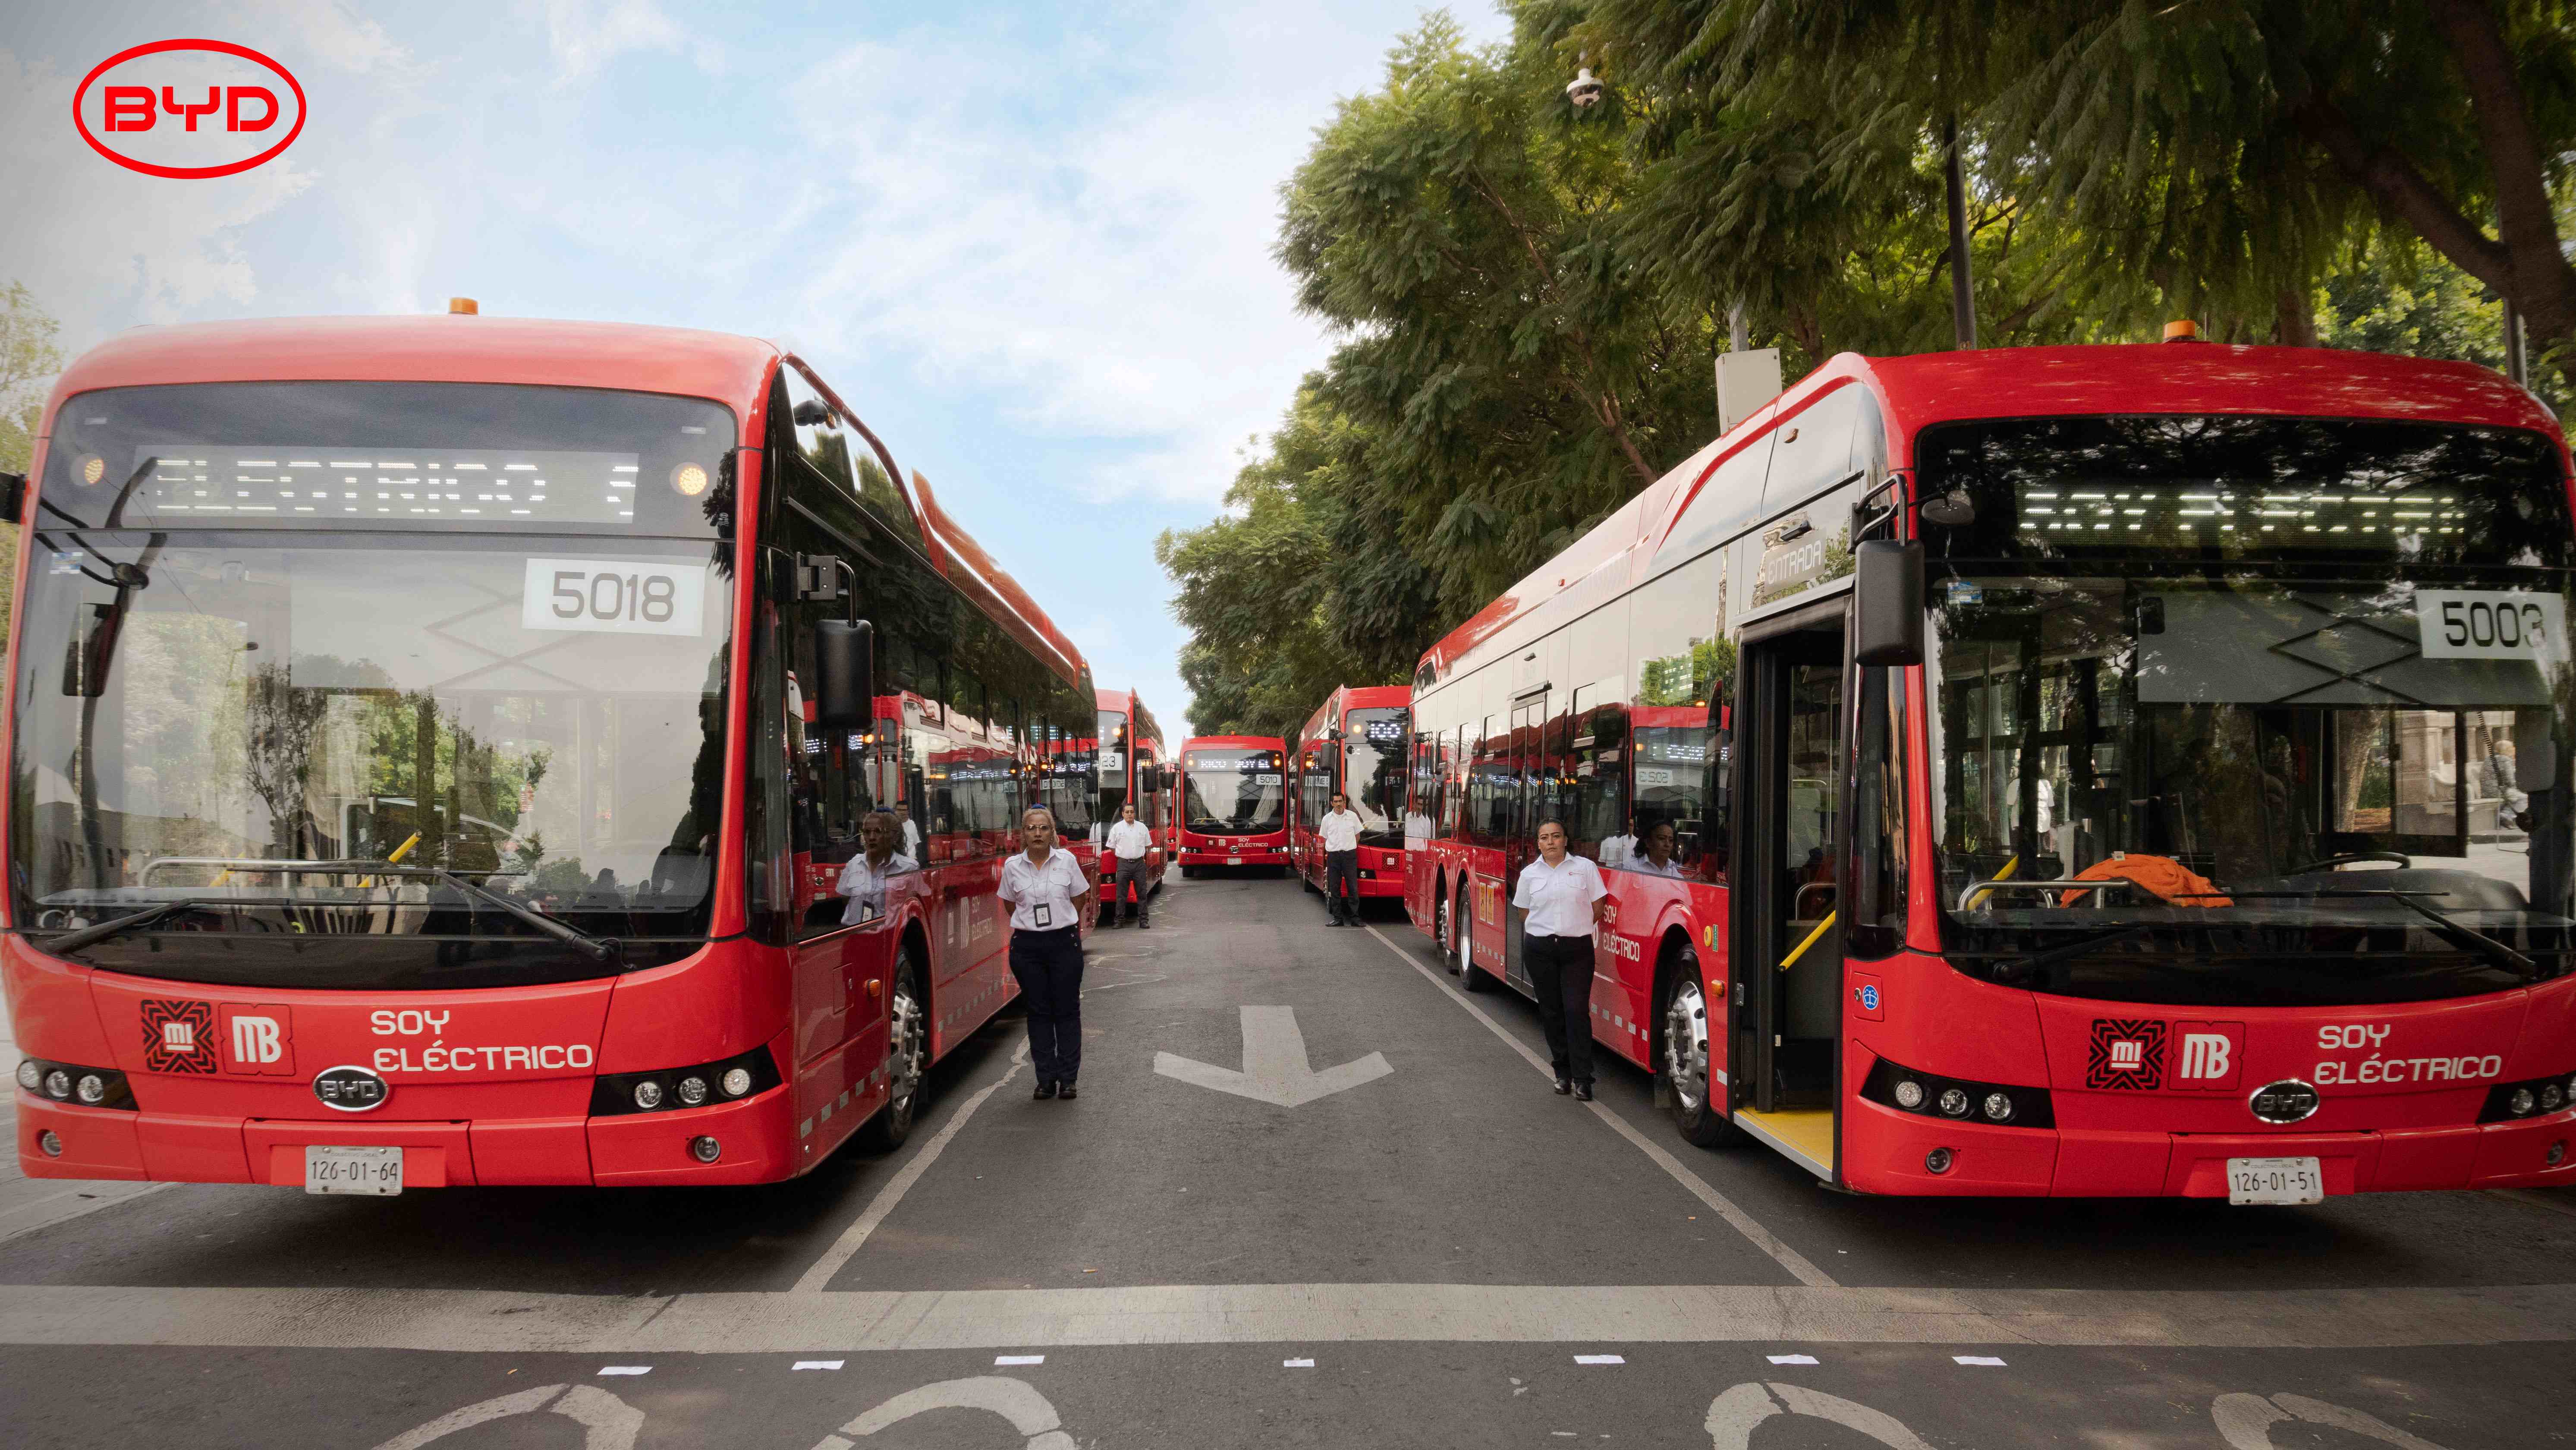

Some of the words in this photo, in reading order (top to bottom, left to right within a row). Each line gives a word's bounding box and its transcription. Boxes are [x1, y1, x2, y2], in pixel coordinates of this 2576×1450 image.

[1768, 539, 1821, 585] ENTRADA
[552, 571, 675, 622] 5018
[2442, 601, 2545, 648] 5003
[1604, 904, 1617, 925] SOY
[1603, 929, 1639, 962] ELÉCTRICO
[371, 1010, 450, 1034] SOY
[2318, 1024, 2390, 1049] SOY
[232, 1016, 282, 1063] MB
[374, 1040, 593, 1072] ELÉCTRICO
[2181, 1034, 2231, 1078] MB
[2315, 1053, 2501, 1084] ELÉCTRICO
[320, 1081, 379, 1099] BYD
[2258, 1094, 2312, 1112] BYD
[312, 1160, 397, 1181] 126-01-64
[2235, 1172, 2317, 1192] 126-01-51
